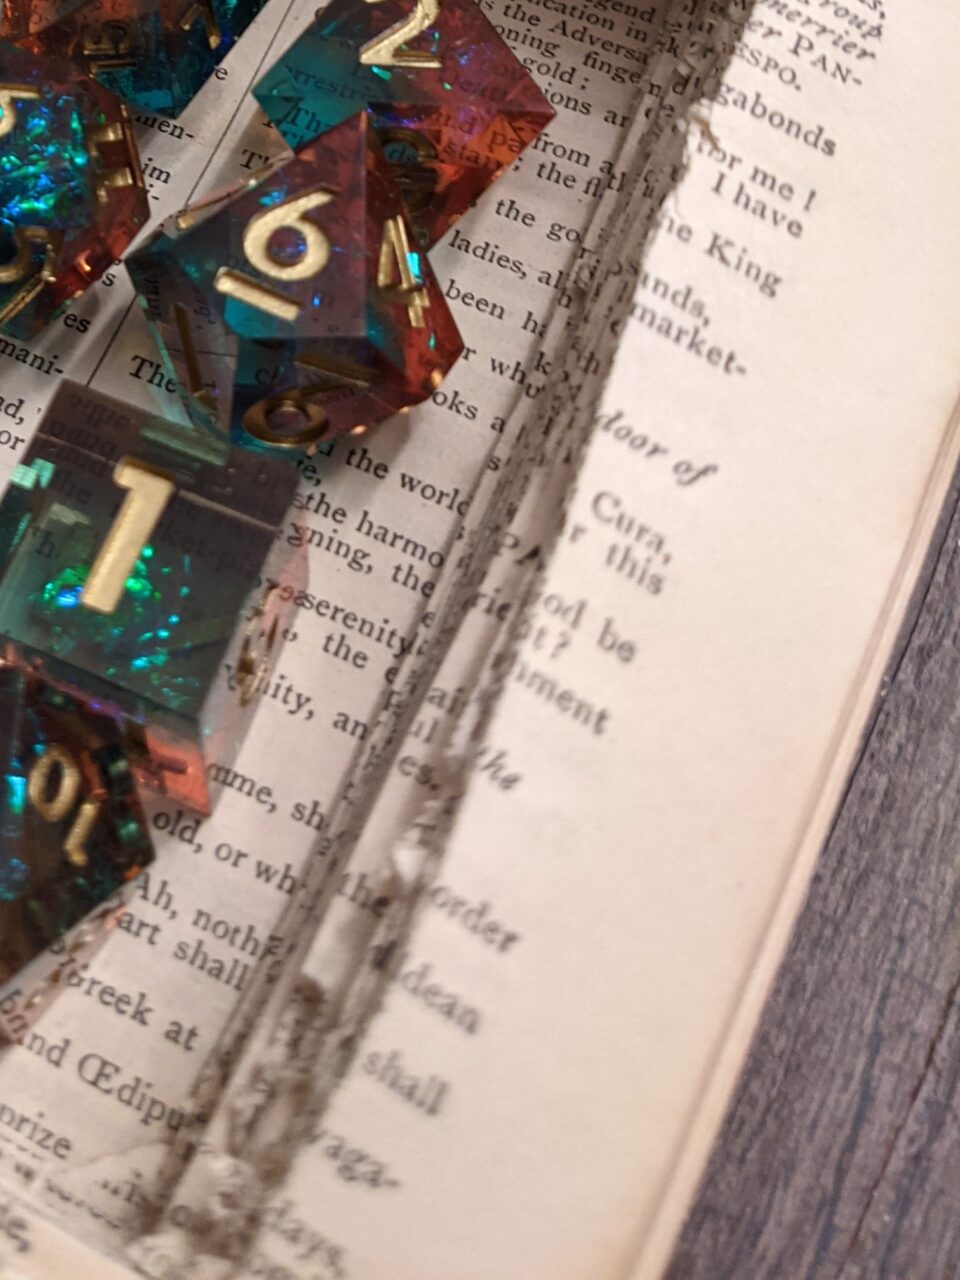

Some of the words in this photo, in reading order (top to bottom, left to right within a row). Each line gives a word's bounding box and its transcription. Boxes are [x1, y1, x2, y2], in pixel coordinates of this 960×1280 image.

[533, 132, 601, 173] from
[733, 179, 804, 240] have
[448, 229, 528, 280] ladies,
[706, 231, 785, 300] King
[445, 278, 506, 322] been
[345, 448, 390, 480] the
[80, 456, 176, 614] 1
[590, 489, 674, 566] Cura,
[604, 542, 667, 596] this
[322, 631, 370, 669] the
[152, 809, 204, 854] old,
[163, 1019, 200, 1054] at
